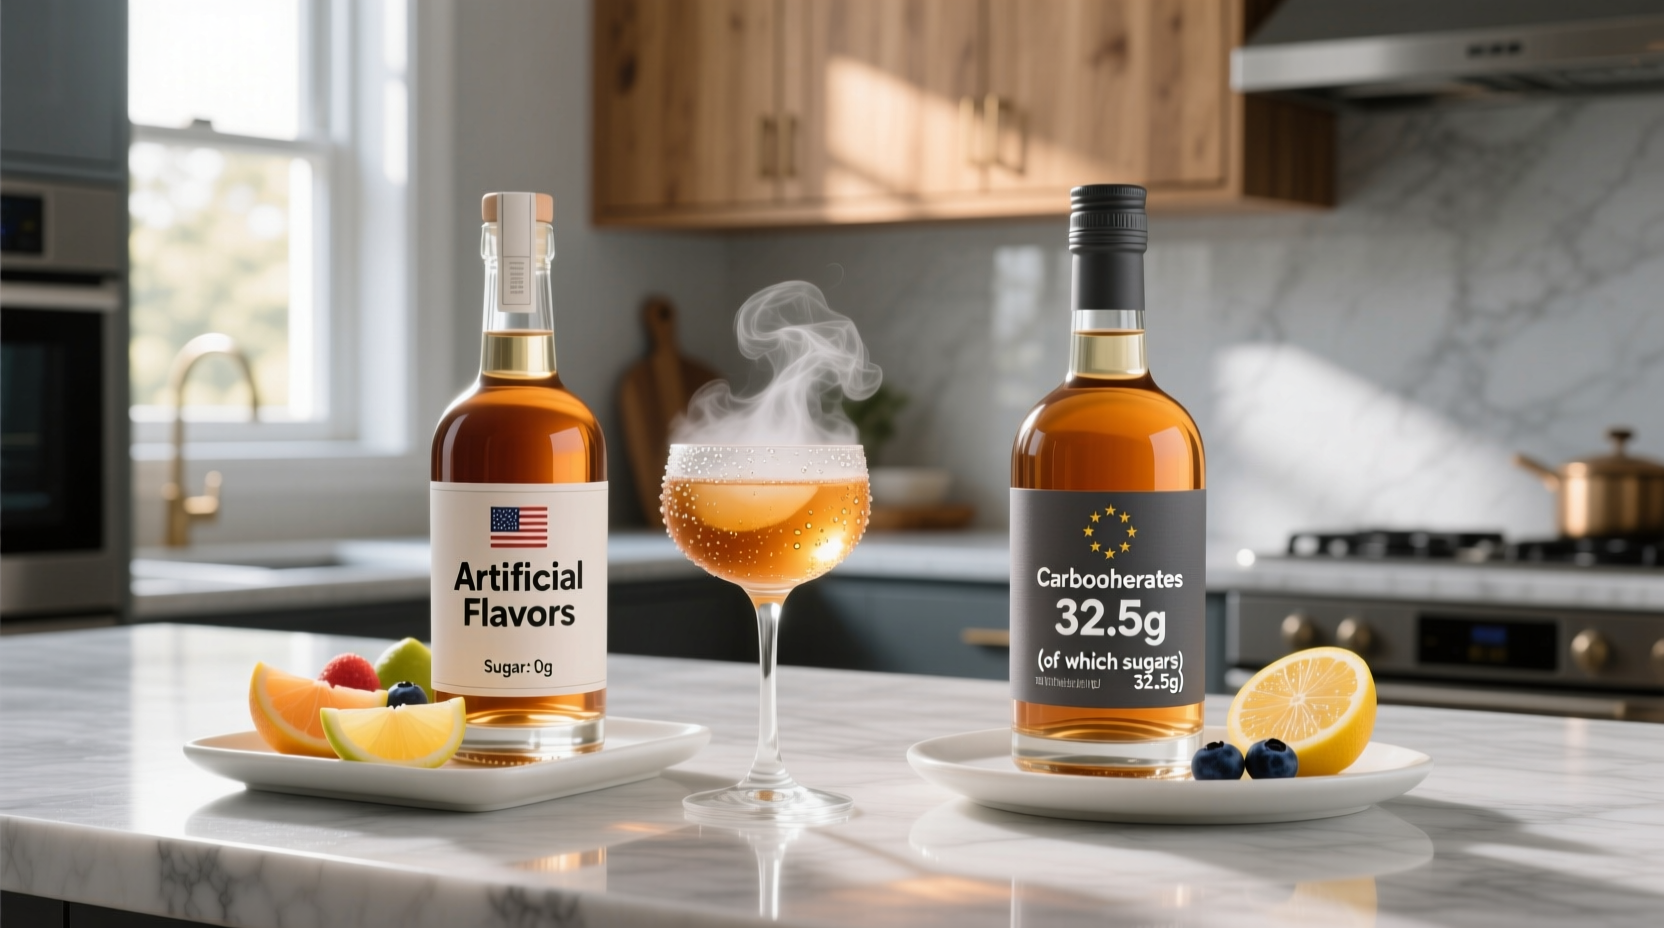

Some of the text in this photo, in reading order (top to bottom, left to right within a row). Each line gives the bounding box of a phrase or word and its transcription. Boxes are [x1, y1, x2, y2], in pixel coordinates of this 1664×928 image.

[454, 560, 583, 591] Artificial
[1037, 567, 1183, 589] Carbooherates
[464, 597, 576, 627] Flavors
[1055, 598, 1166, 646] 32.5g
[484, 659, 553, 677] Sugar: 0g
[1038, 648, 1184, 674] (of which sugars)
[1134, 671, 1184, 694] 32.5g)
